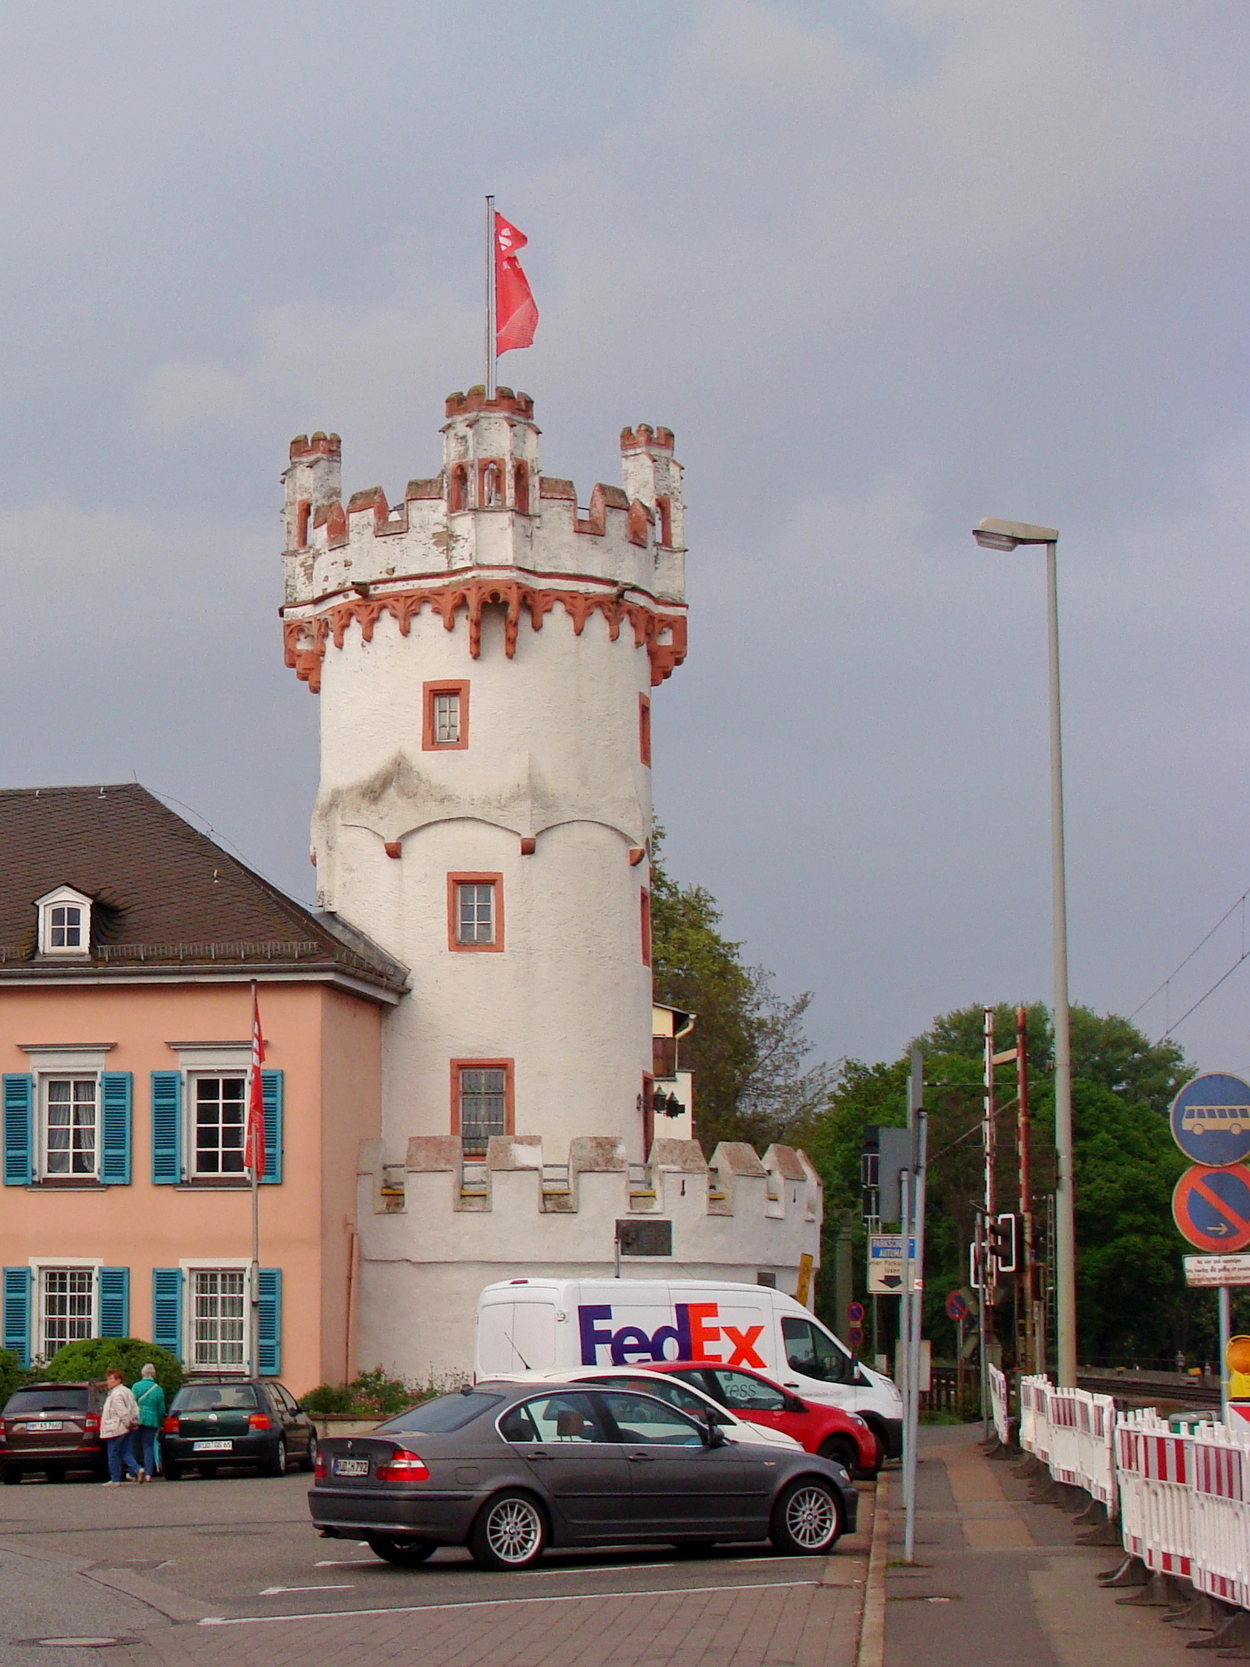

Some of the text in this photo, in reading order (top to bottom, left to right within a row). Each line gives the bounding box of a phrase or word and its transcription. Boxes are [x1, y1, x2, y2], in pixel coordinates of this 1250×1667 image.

[879, 1249, 904, 1258] AUTOMA
[578, 1303, 768, 1368] FedEx
[356, 1462, 368, 1474] 792
